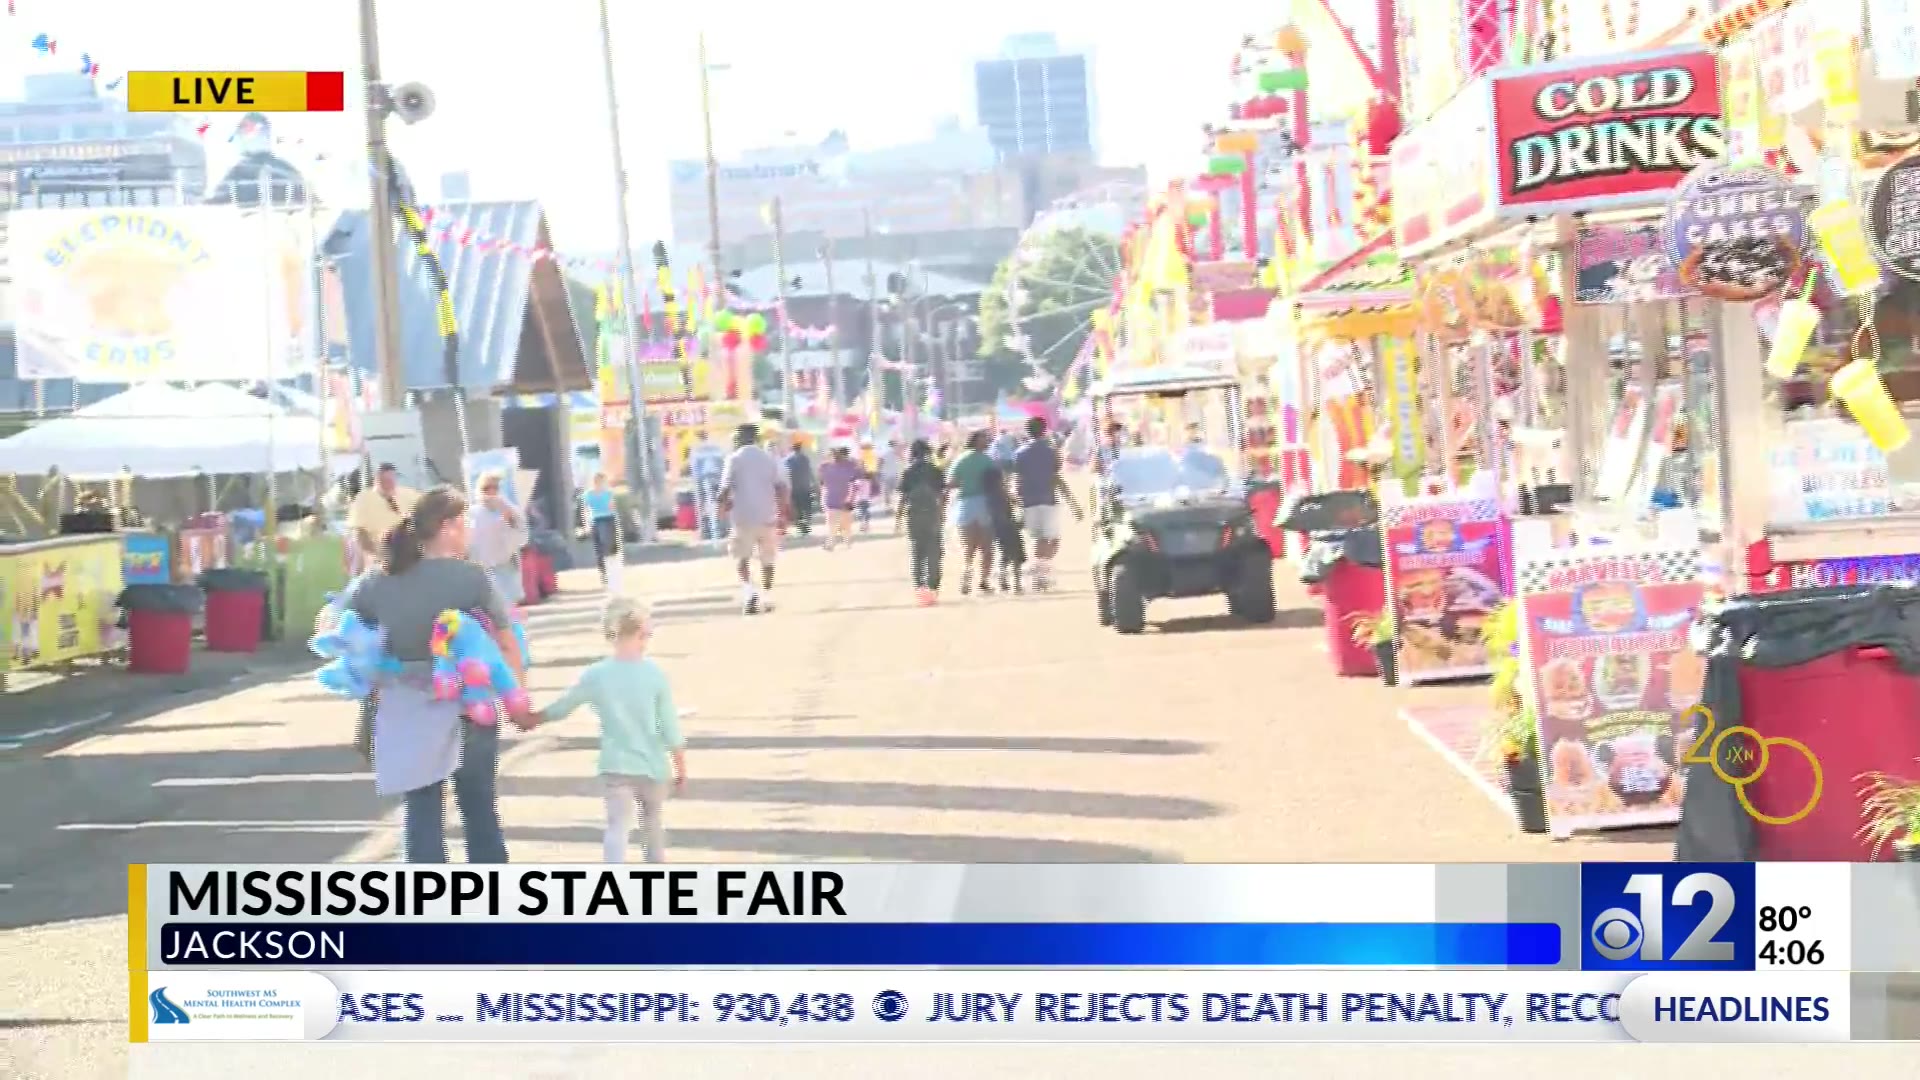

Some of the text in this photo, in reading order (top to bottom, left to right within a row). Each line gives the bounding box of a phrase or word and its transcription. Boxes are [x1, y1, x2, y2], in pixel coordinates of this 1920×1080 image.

[1535, 68, 1693, 120] COLD
[1512, 115, 1726, 192] DRINKS
[1674, 188, 1802, 218] FUNNEL
[44, 214, 211, 269] ELEPHANT
[1685, 214, 1794, 242] CAKES
[85, 339, 177, 365] EARS
